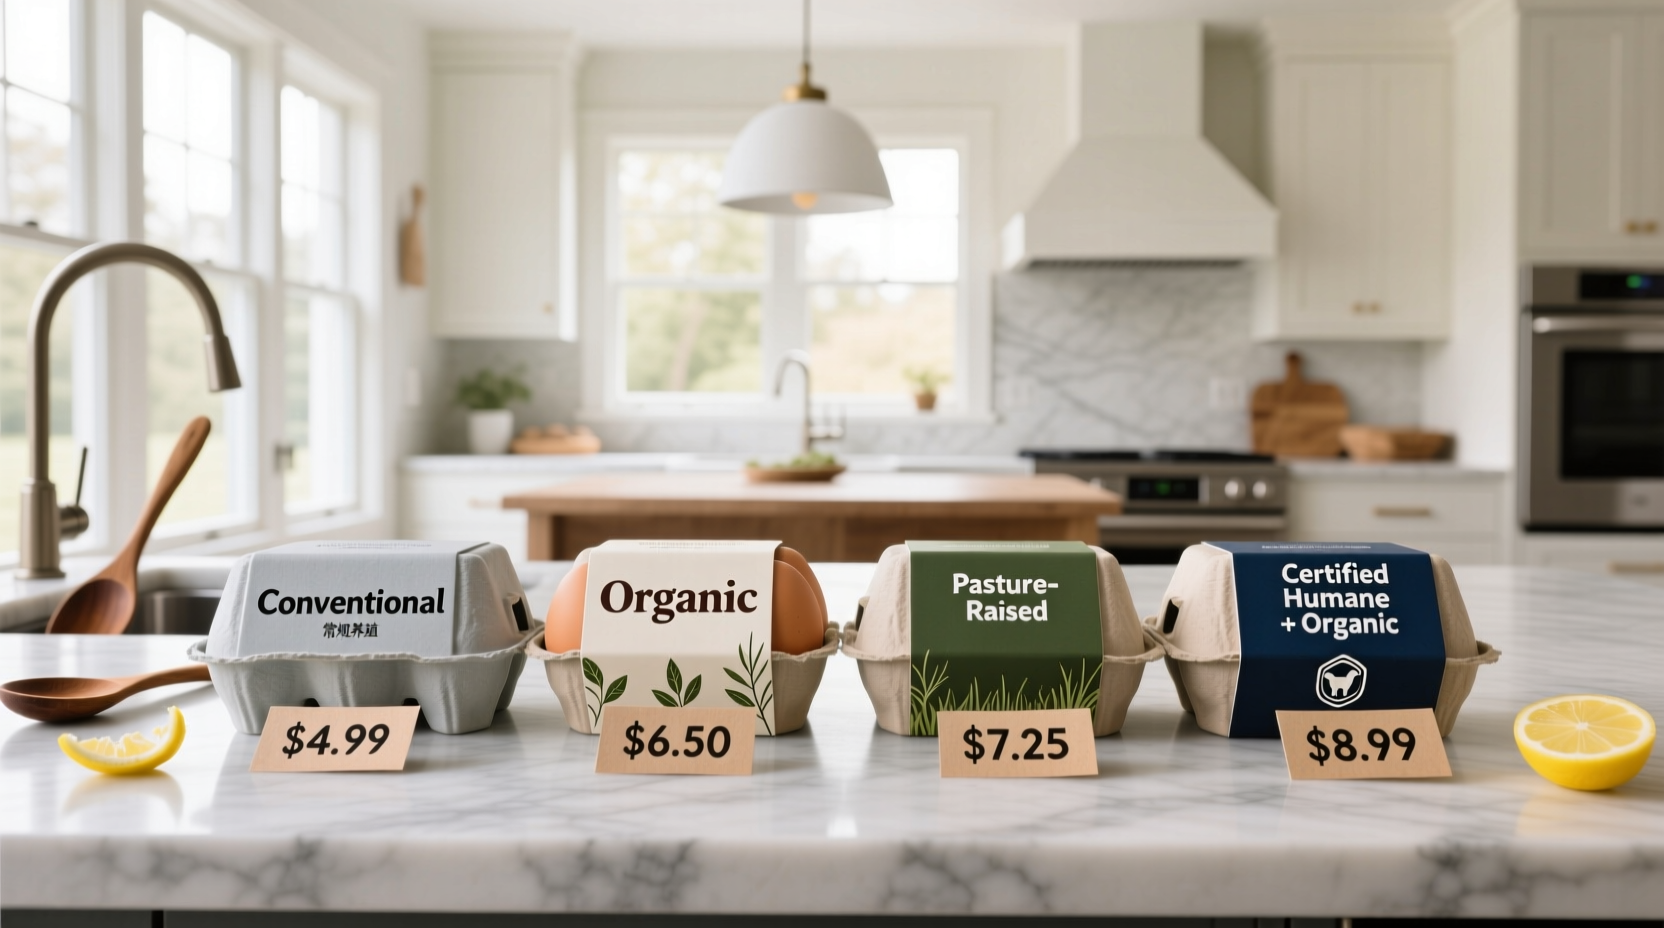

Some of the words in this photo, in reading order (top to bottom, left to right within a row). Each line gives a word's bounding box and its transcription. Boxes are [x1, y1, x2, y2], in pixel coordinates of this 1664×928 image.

[952, 572, 1059, 595] Pasture-
[1281, 561, 1390, 585] Certified
[257, 587, 445, 616] Conventional
[600, 579, 758, 623] Organic
[966, 599, 1048, 622] Raised
[1283, 587, 1390, 609] Humane
[1280, 616, 1296, 632] +
[1301, 612, 1399, 641] Organic
[282, 721, 390, 759] $4.99
[623, 720, 731, 761] $6.50
[963, 724, 1069, 765] $7.25
[1306, 725, 1416, 767] $8.99
